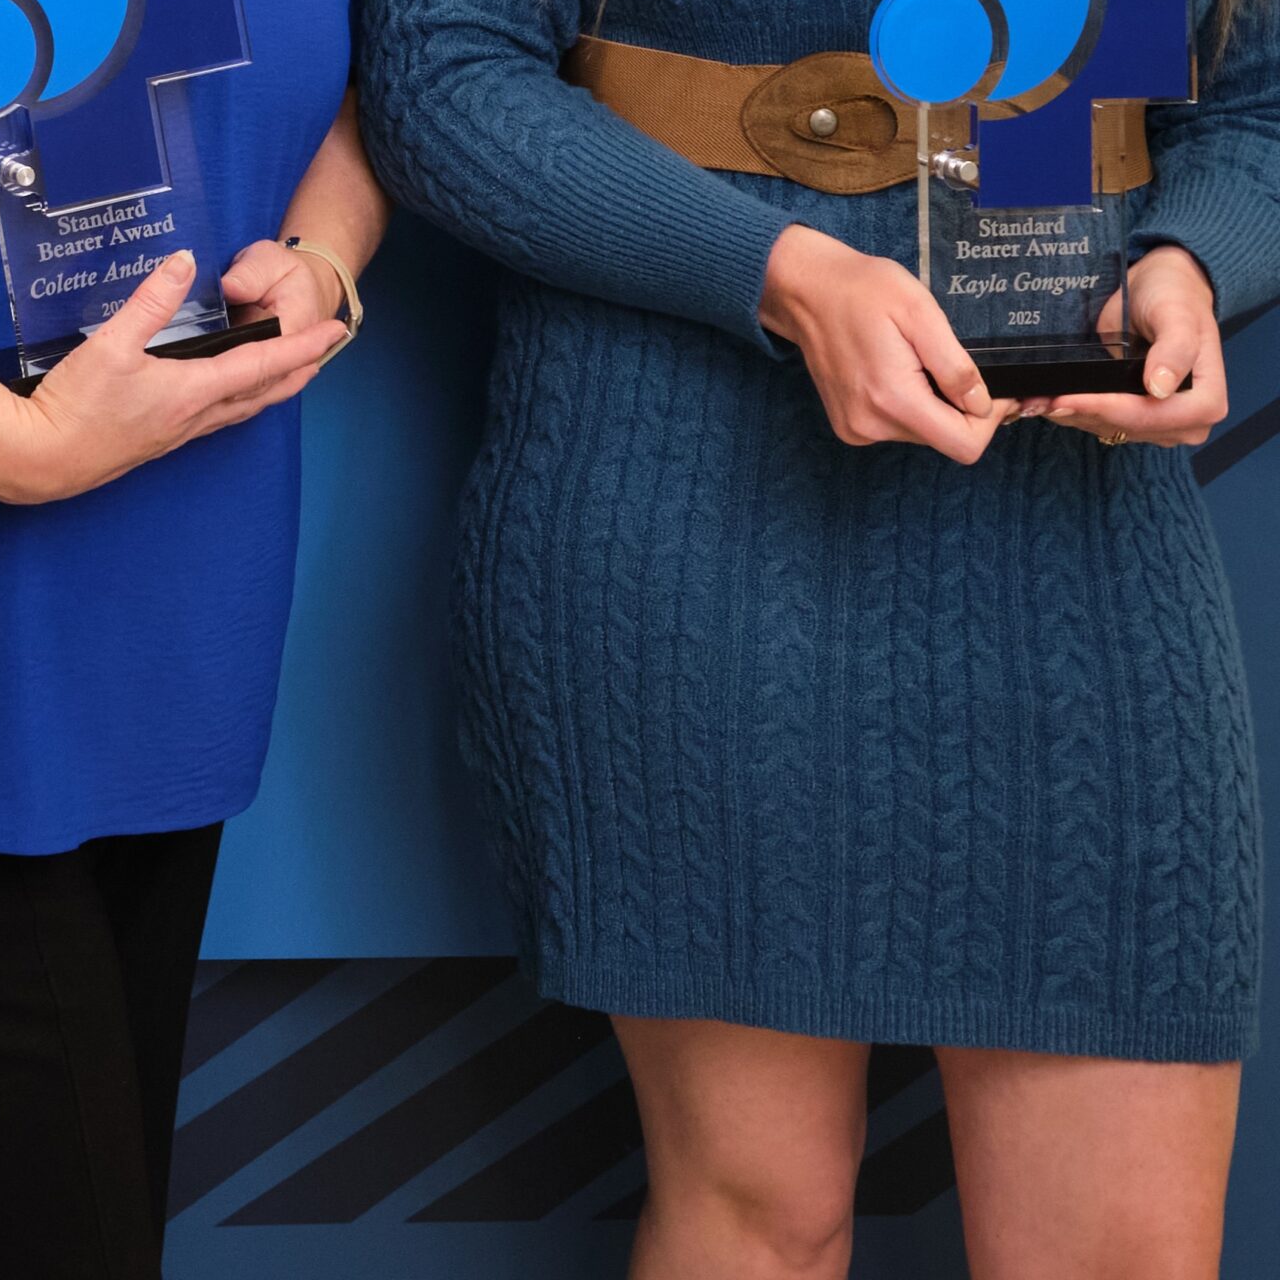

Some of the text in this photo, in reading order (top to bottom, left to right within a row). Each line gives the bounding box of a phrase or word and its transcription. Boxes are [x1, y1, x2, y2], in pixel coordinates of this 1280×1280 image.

[57, 199, 148, 236] Standard
[978, 215, 1065, 238] Standard
[37, 213, 176, 263] Bearer Award
[955, 236, 1091, 260] Bearer Award
[30, 253, 170, 300] Colette Ander
[947, 271, 1100, 299] Kayla Gongwer
[101, 299, 127, 318] 20
[1007, 310, 1041, 326] 2025
